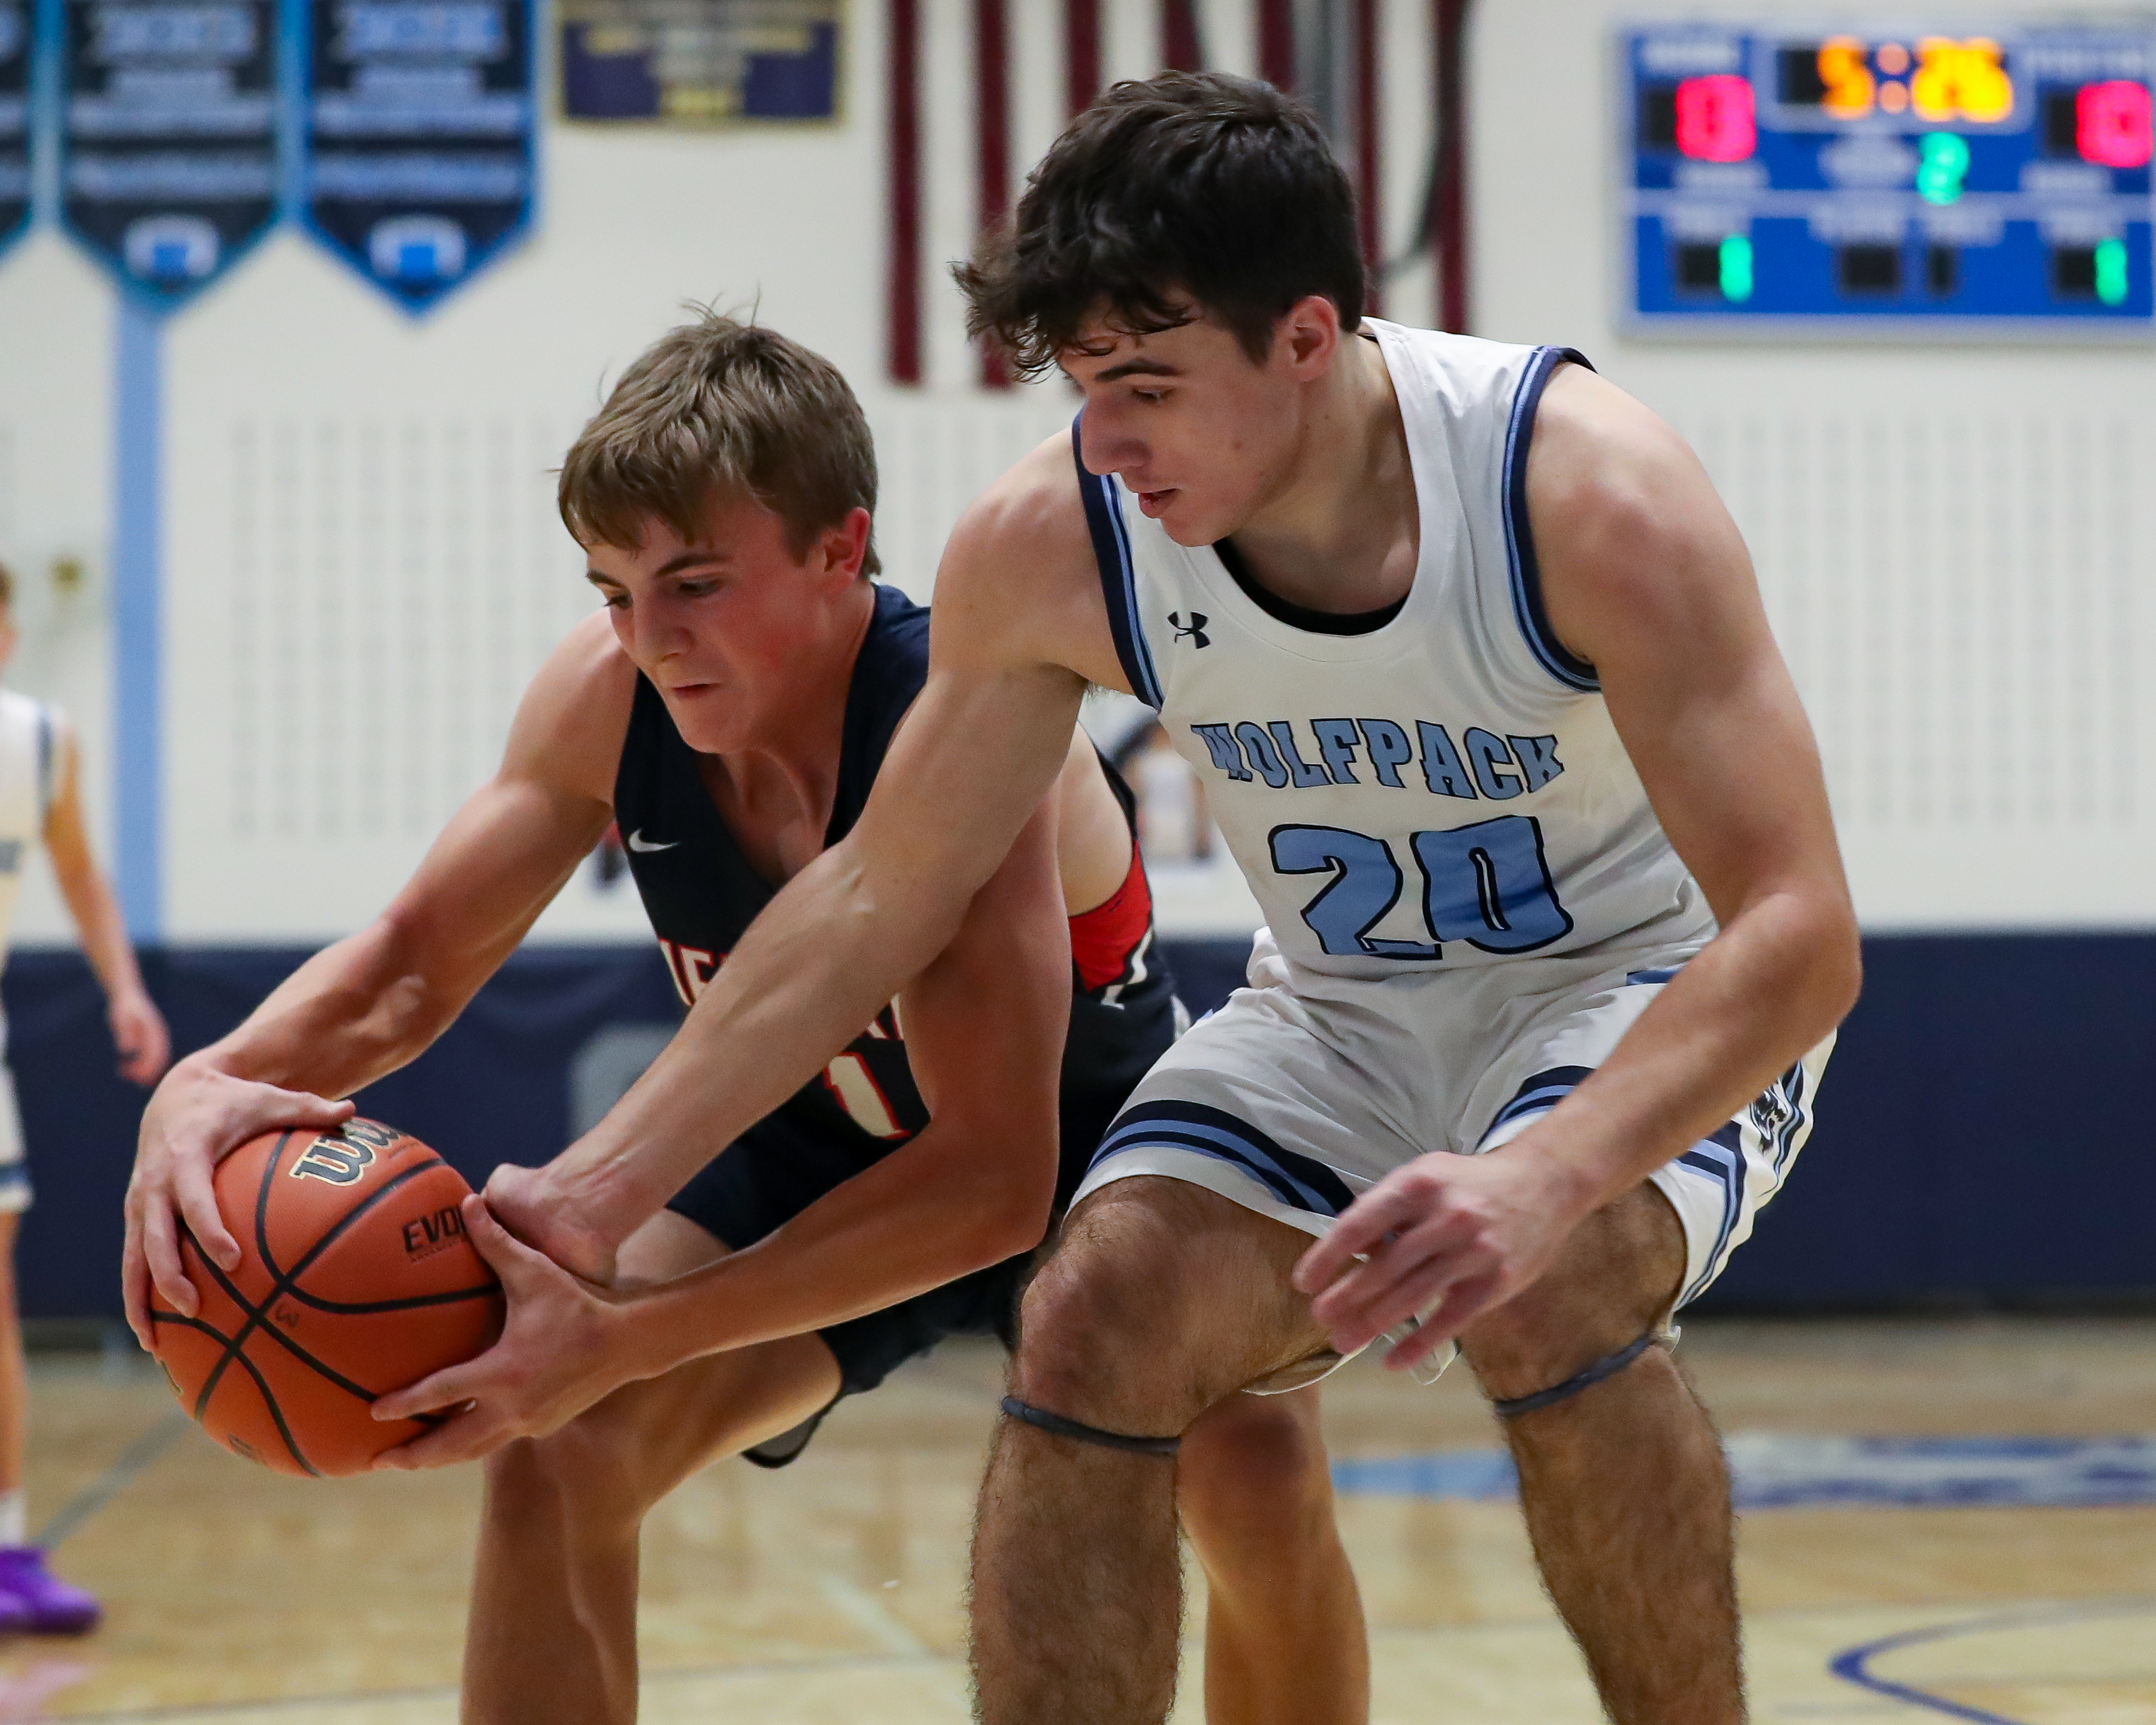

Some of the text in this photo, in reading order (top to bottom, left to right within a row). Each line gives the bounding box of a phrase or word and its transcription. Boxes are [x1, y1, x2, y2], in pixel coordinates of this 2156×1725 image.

[1676, 74, 1757, 162] 0
[1817, 35, 2013, 123] 5:26
[1191, 718, 1565, 800] WOLFPACK
[1267, 815, 1574, 960] 20
